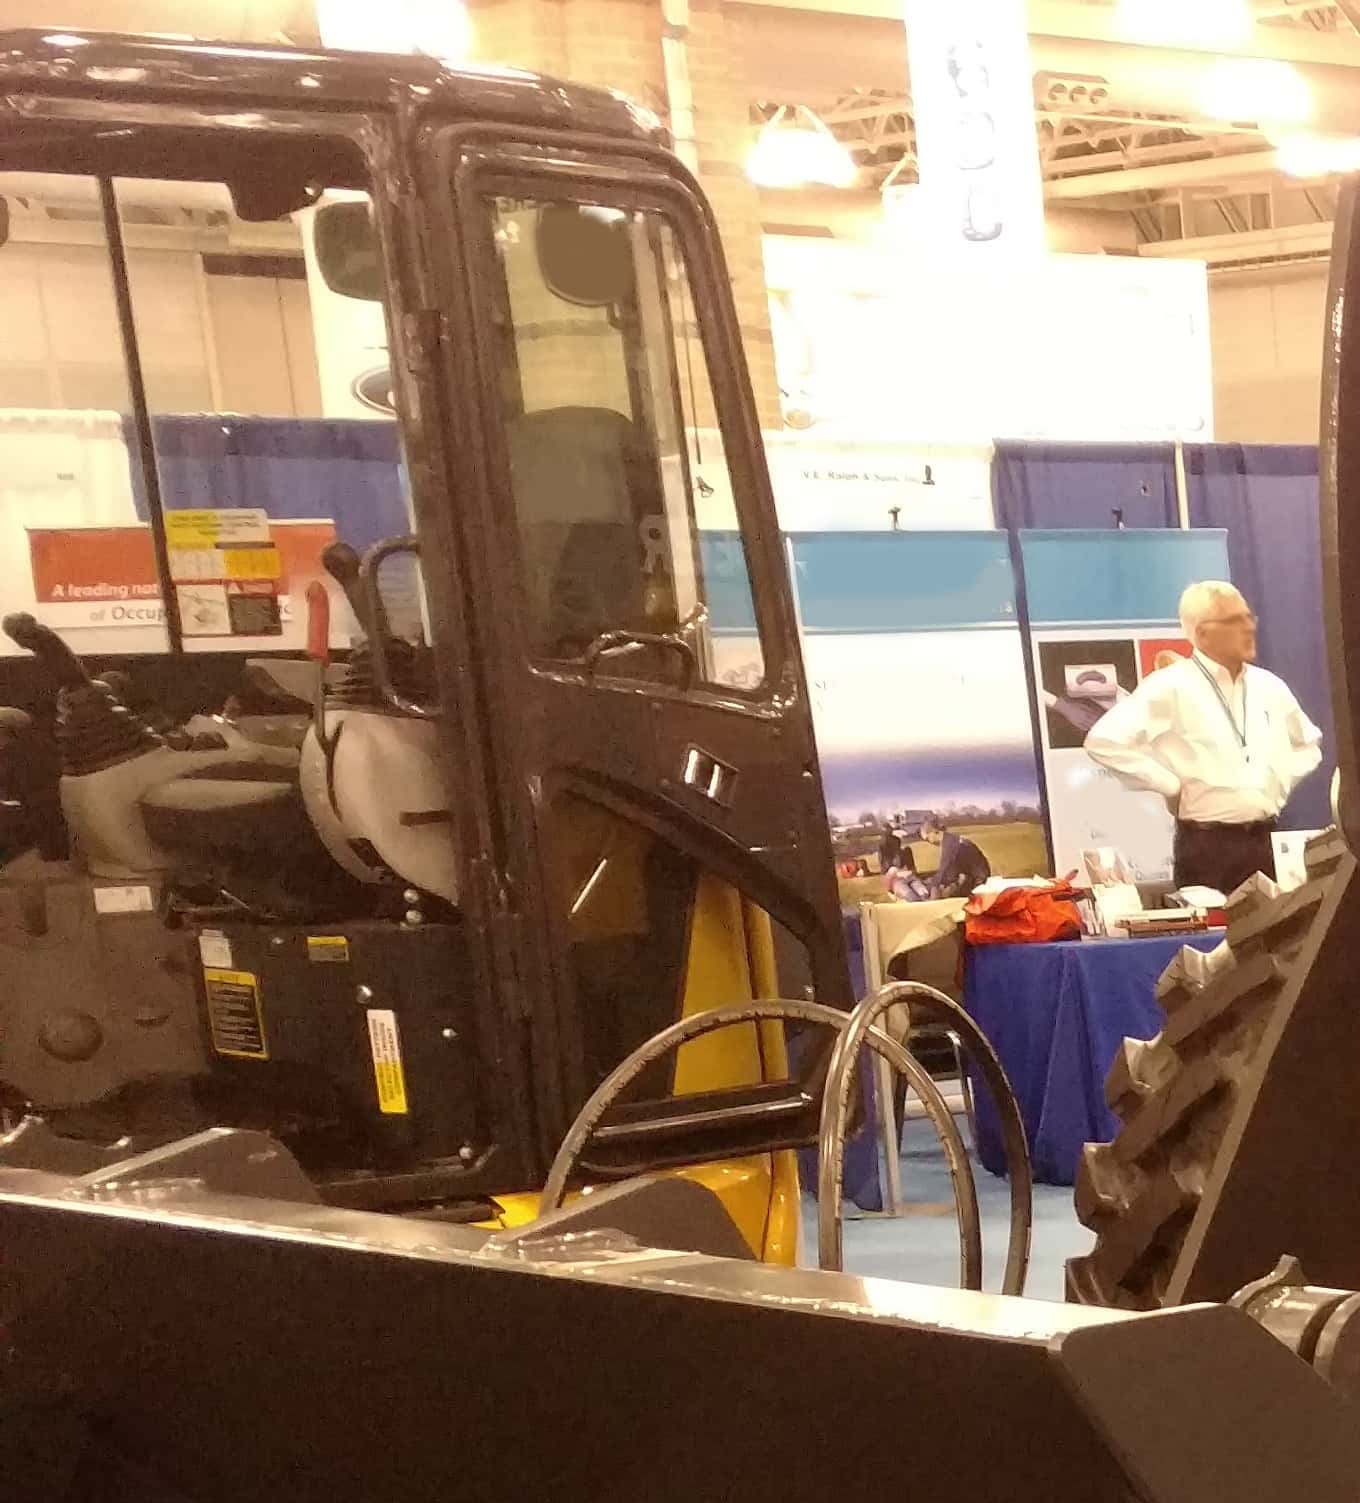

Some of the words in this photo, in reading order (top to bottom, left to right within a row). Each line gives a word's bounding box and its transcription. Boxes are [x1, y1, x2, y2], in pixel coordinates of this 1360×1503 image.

[67, 583, 129, 600] leading
[132, 583, 160, 596] nat
[111, 605, 169, 622] Occup
